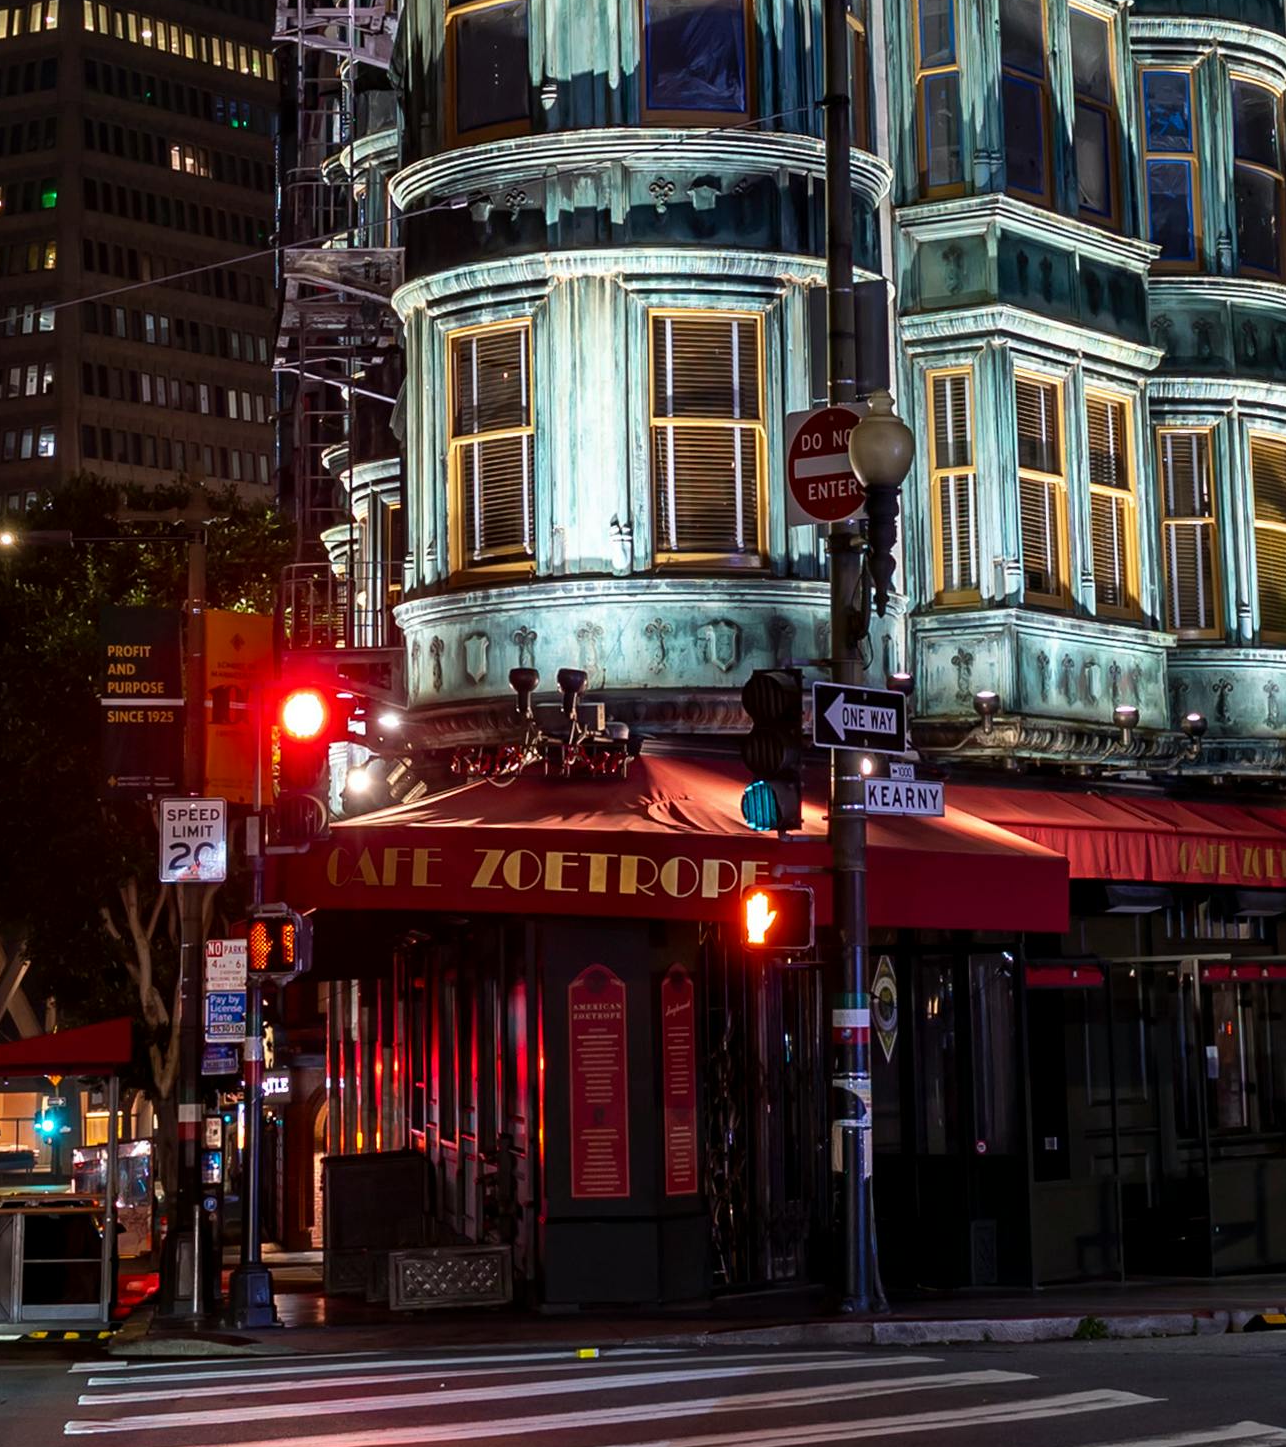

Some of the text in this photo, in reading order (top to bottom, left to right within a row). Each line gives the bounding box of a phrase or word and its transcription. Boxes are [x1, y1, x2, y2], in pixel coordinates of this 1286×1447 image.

[801, 428, 852, 451] DO NO
[808, 478, 858, 501] ENTER
[106, 645, 152, 658] PROFIT
[106, 663, 136, 675] AND
[106, 681, 165, 694] PURPOSE
[106, 710, 174, 723] SINCE 1925
[842, 707, 894, 731] ONE WAY
[868, 785, 939, 810] KEARNY
[167, 809, 220, 821] SPEED
[172, 825, 214, 838] LIMIT
[1179, 842, 1230, 876] CAFE
[326, 847, 442, 887] CAFE
[208, 942, 222, 955] NO
[210, 994, 240, 1006] Pay by
[210, 1005, 243, 1013] License
[210, 1012, 233, 1022] Plate
